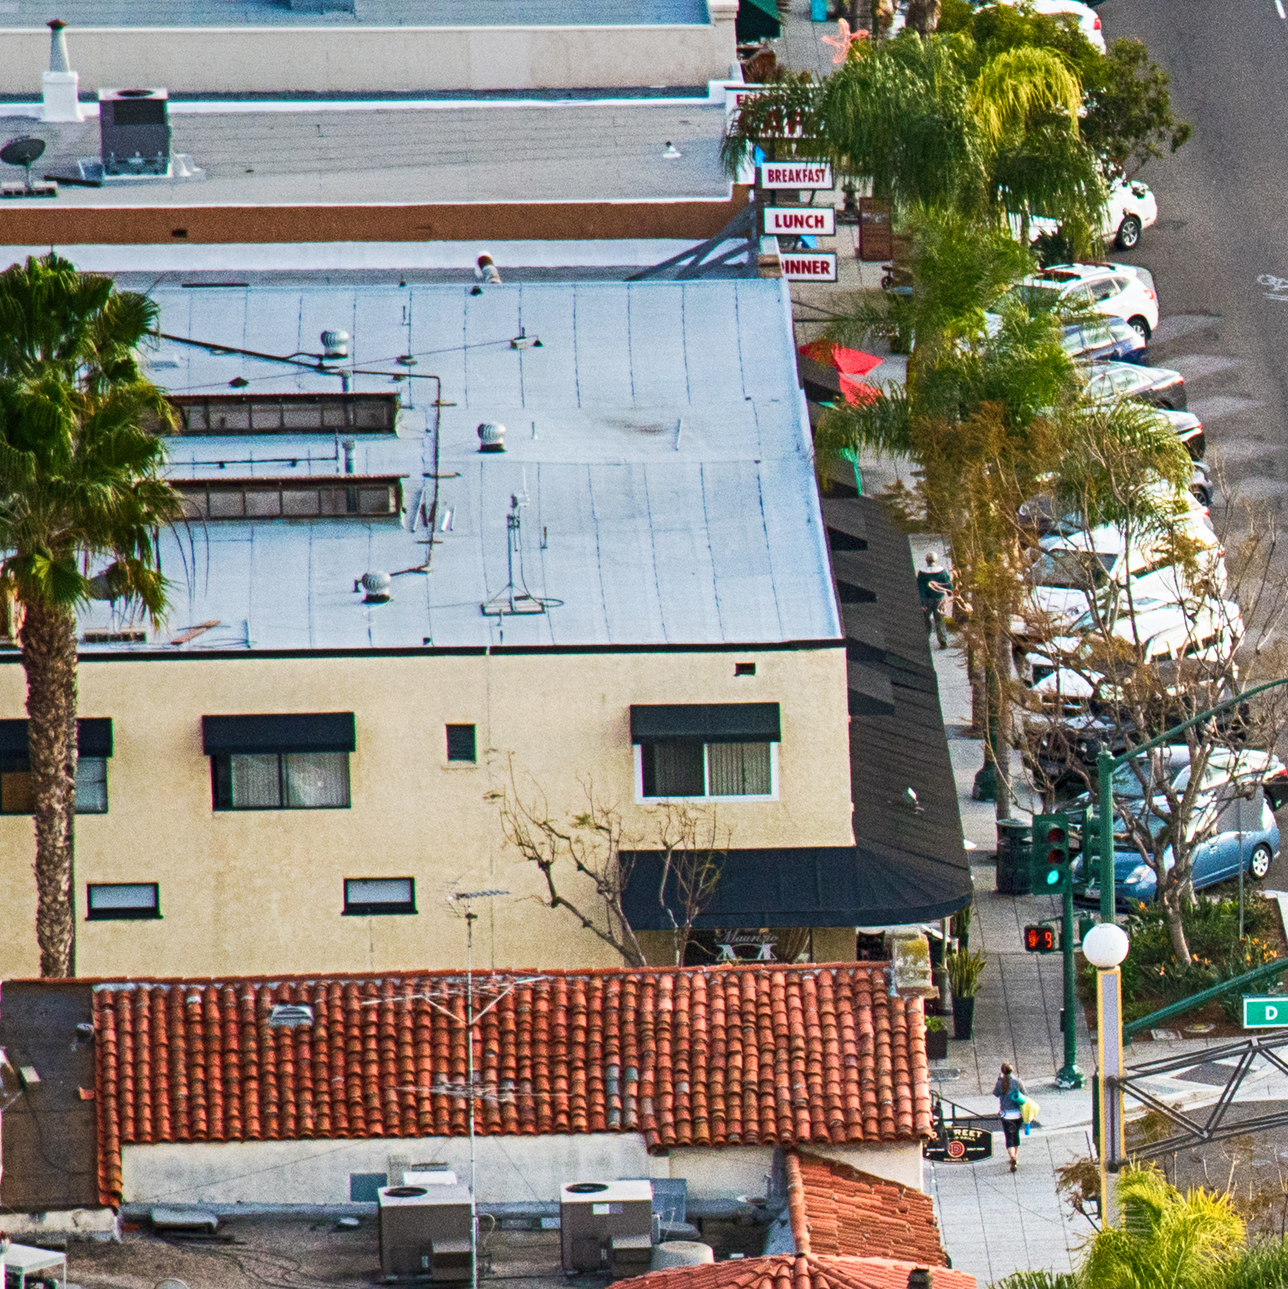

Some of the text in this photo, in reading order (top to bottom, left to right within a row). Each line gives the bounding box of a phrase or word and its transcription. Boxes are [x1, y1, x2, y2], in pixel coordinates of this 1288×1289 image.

[767, 168, 825, 183] BREAKFAST
[774, 213, 825, 229] LUNCH
[781, 259, 830, 275] INNER
[1044, 931, 1053, 948] 9
[1265, 1005, 1278, 1020] D
